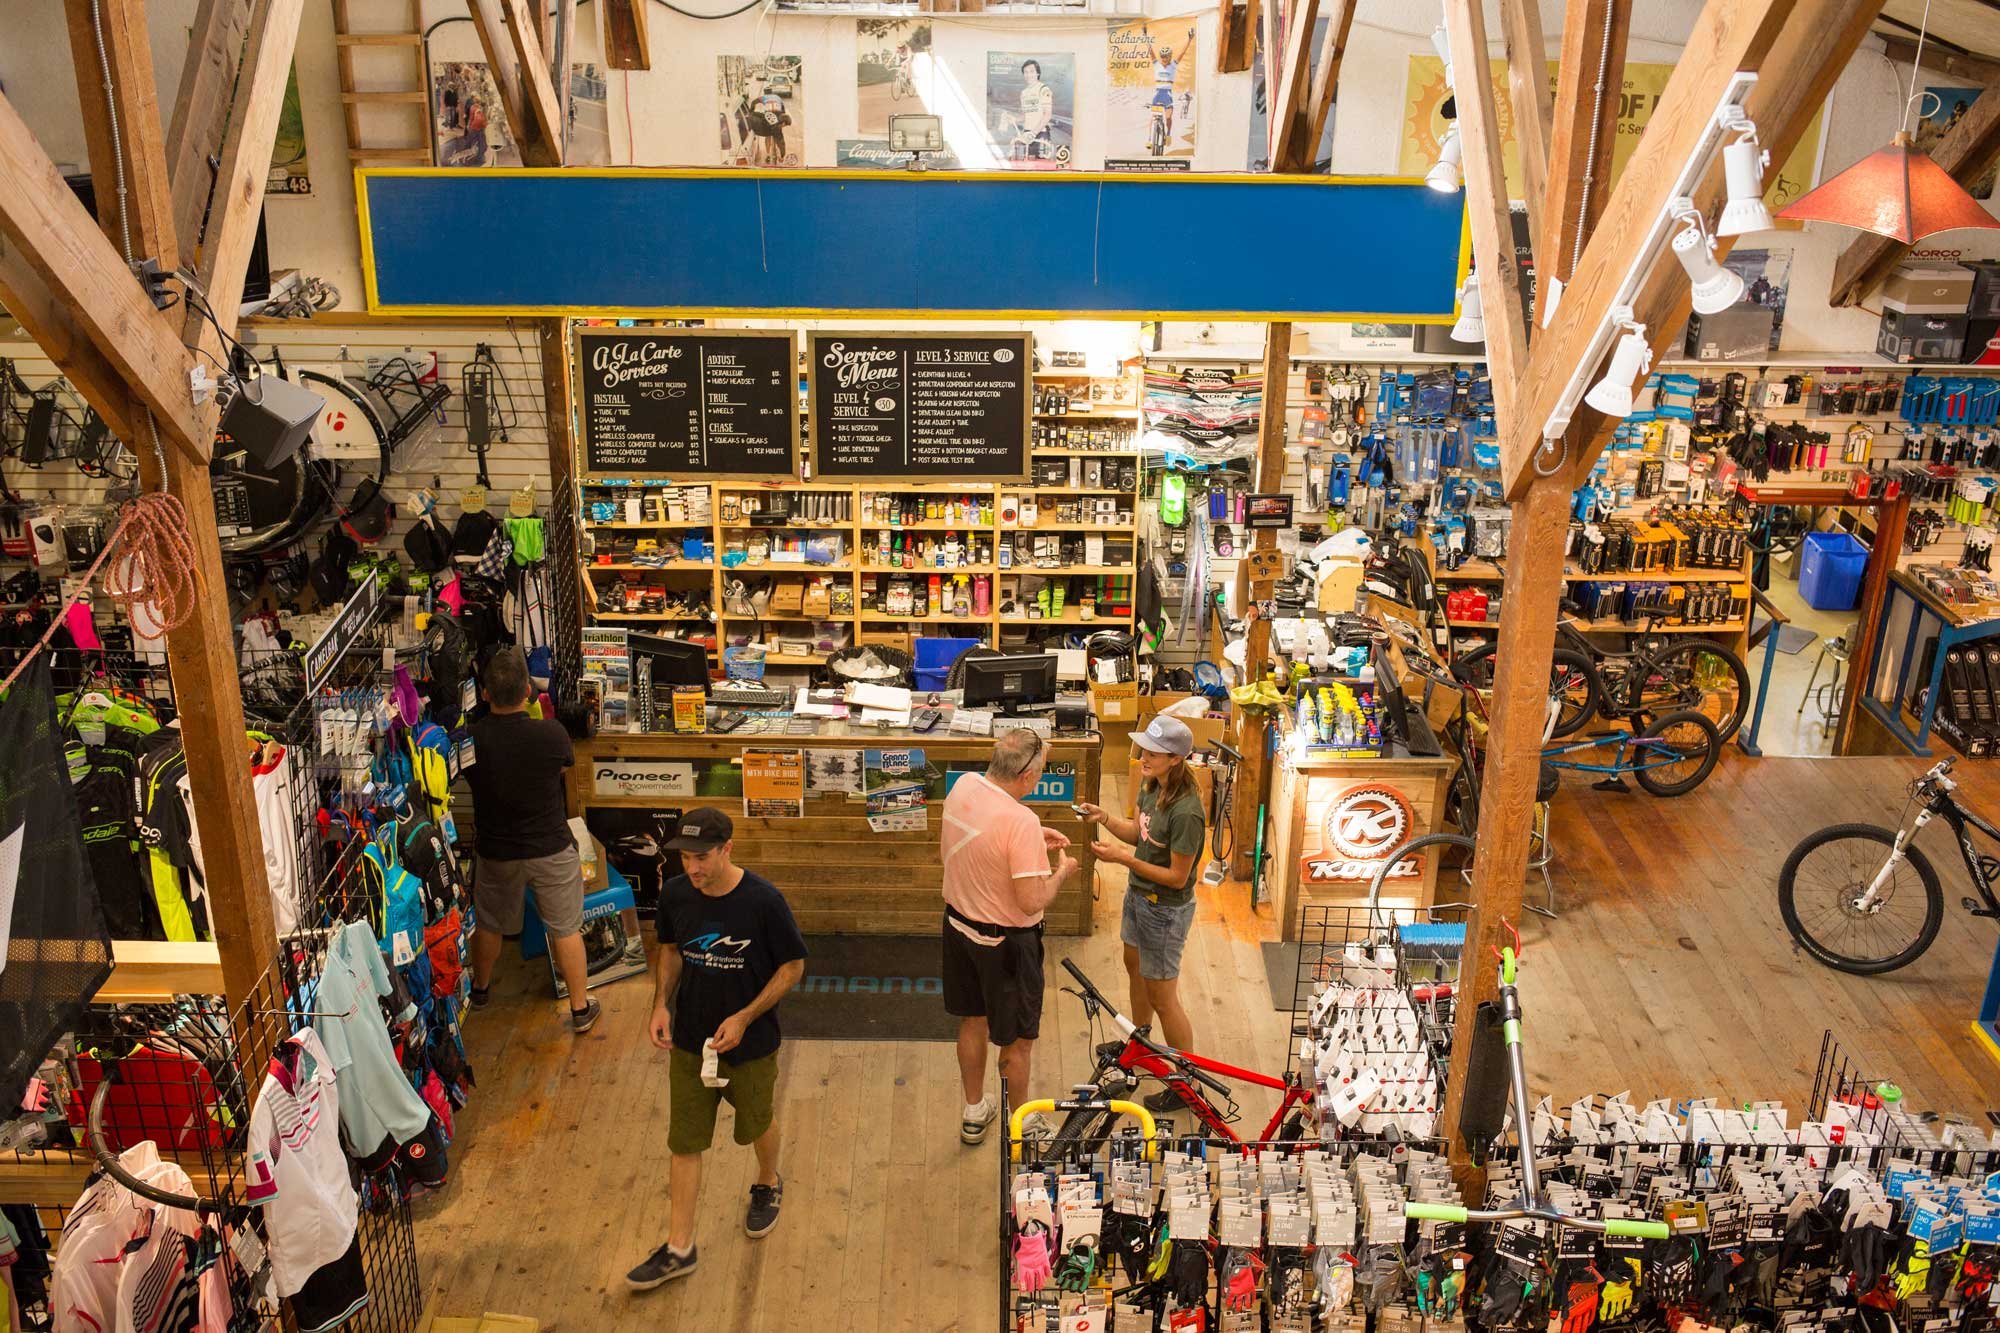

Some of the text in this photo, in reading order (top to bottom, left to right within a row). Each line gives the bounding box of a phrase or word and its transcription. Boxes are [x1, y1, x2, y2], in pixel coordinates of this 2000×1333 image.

[290, 178, 308, 192] 48
[593, 342, 682, 370] A La Carte
[707, 355, 736, 365] ADJUST
[824, 342, 897, 368] Service
[916, 349, 989, 362] LEVEL 3 SERVICE
[603, 361, 668, 388] Services
[837, 361, 898, 388] Menu
[594, 394, 626, 404] INSTALL
[708, 393, 728, 403] TRUE
[834, 391, 870, 404] LEVEL 4
[834, 407, 869, 416] SERVICE
[709, 423, 733, 432] CHASE
[584, 633, 624, 642] triathlon
[596, 768, 682, 781] Pioneer
